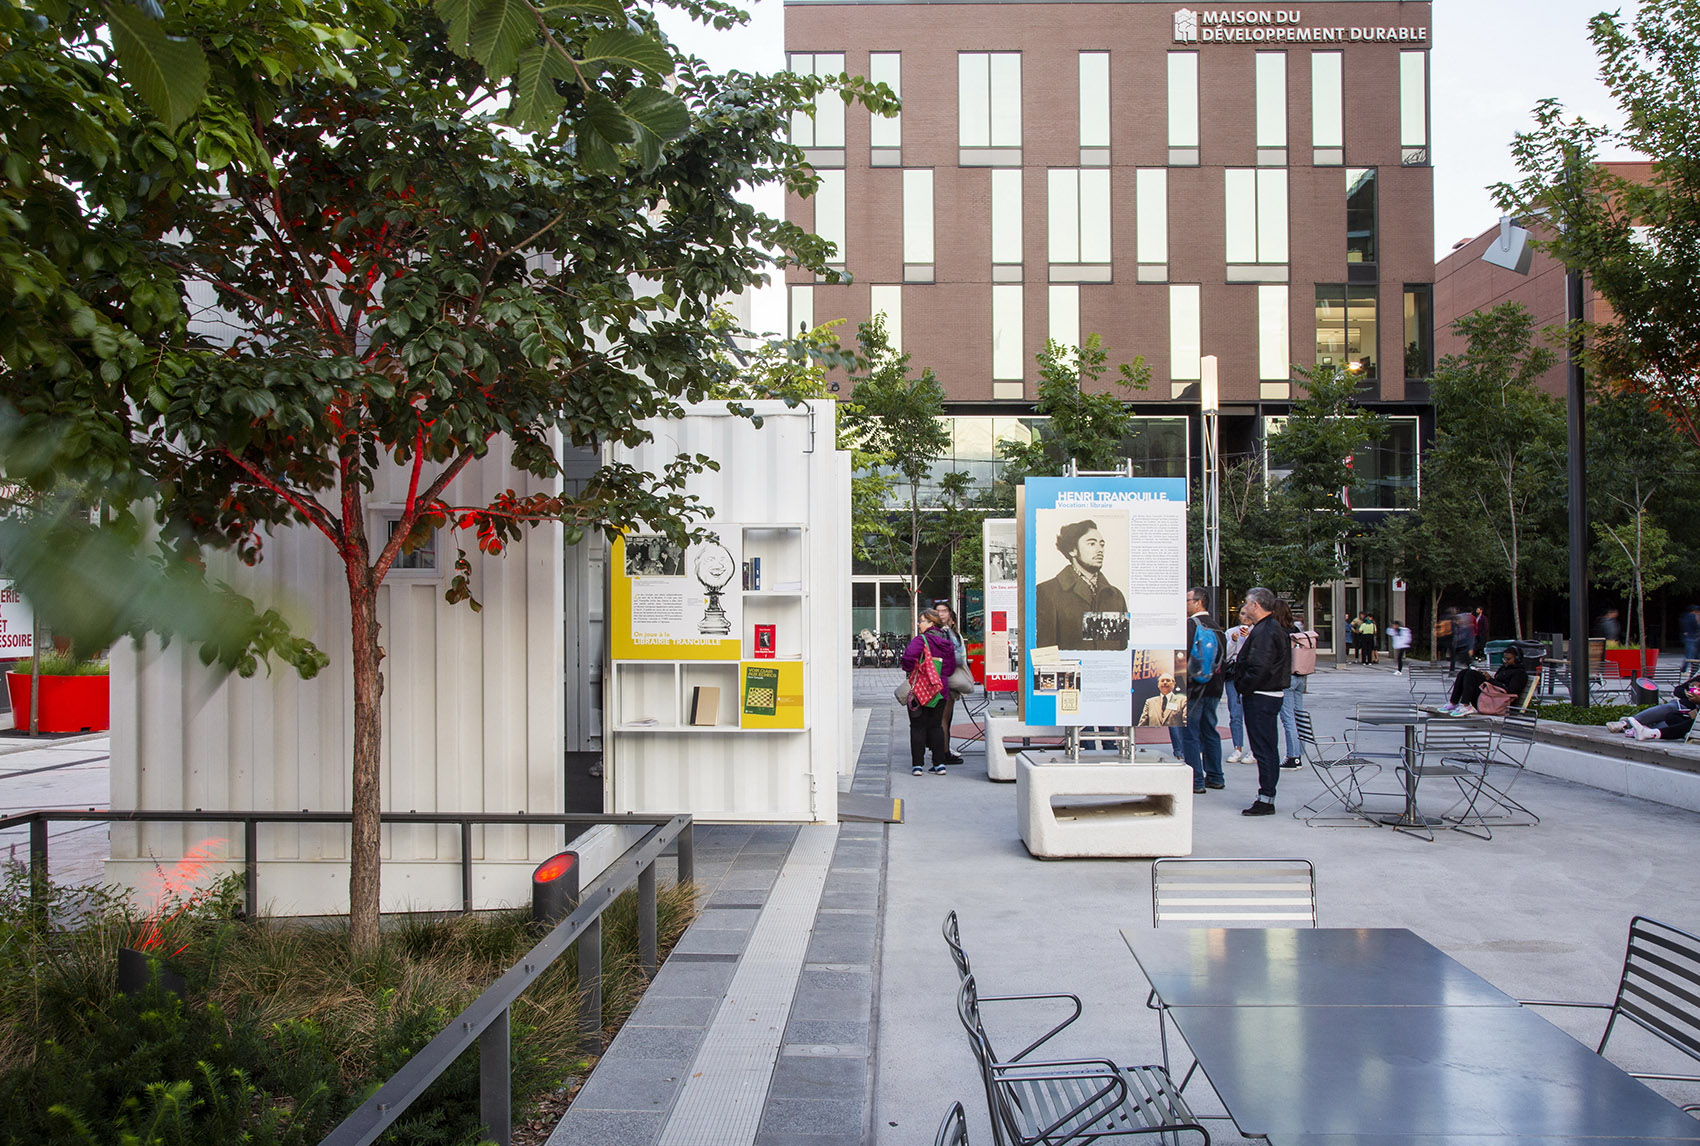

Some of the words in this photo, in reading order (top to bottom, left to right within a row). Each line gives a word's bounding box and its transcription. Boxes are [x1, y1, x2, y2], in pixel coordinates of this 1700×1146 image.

[1202, 10, 1272, 24] MAISON
[1276, 10, 1300, 24] DU
[1202, 24, 1345, 42] DÉVELOPPEMENT
[1350, 27, 1427, 42] DURABLE
[1057, 491, 1094, 501] HENRI
[633, 638, 670, 646] LIBRAIRIE
[672, 638, 721, 646] TRANQUILLE
